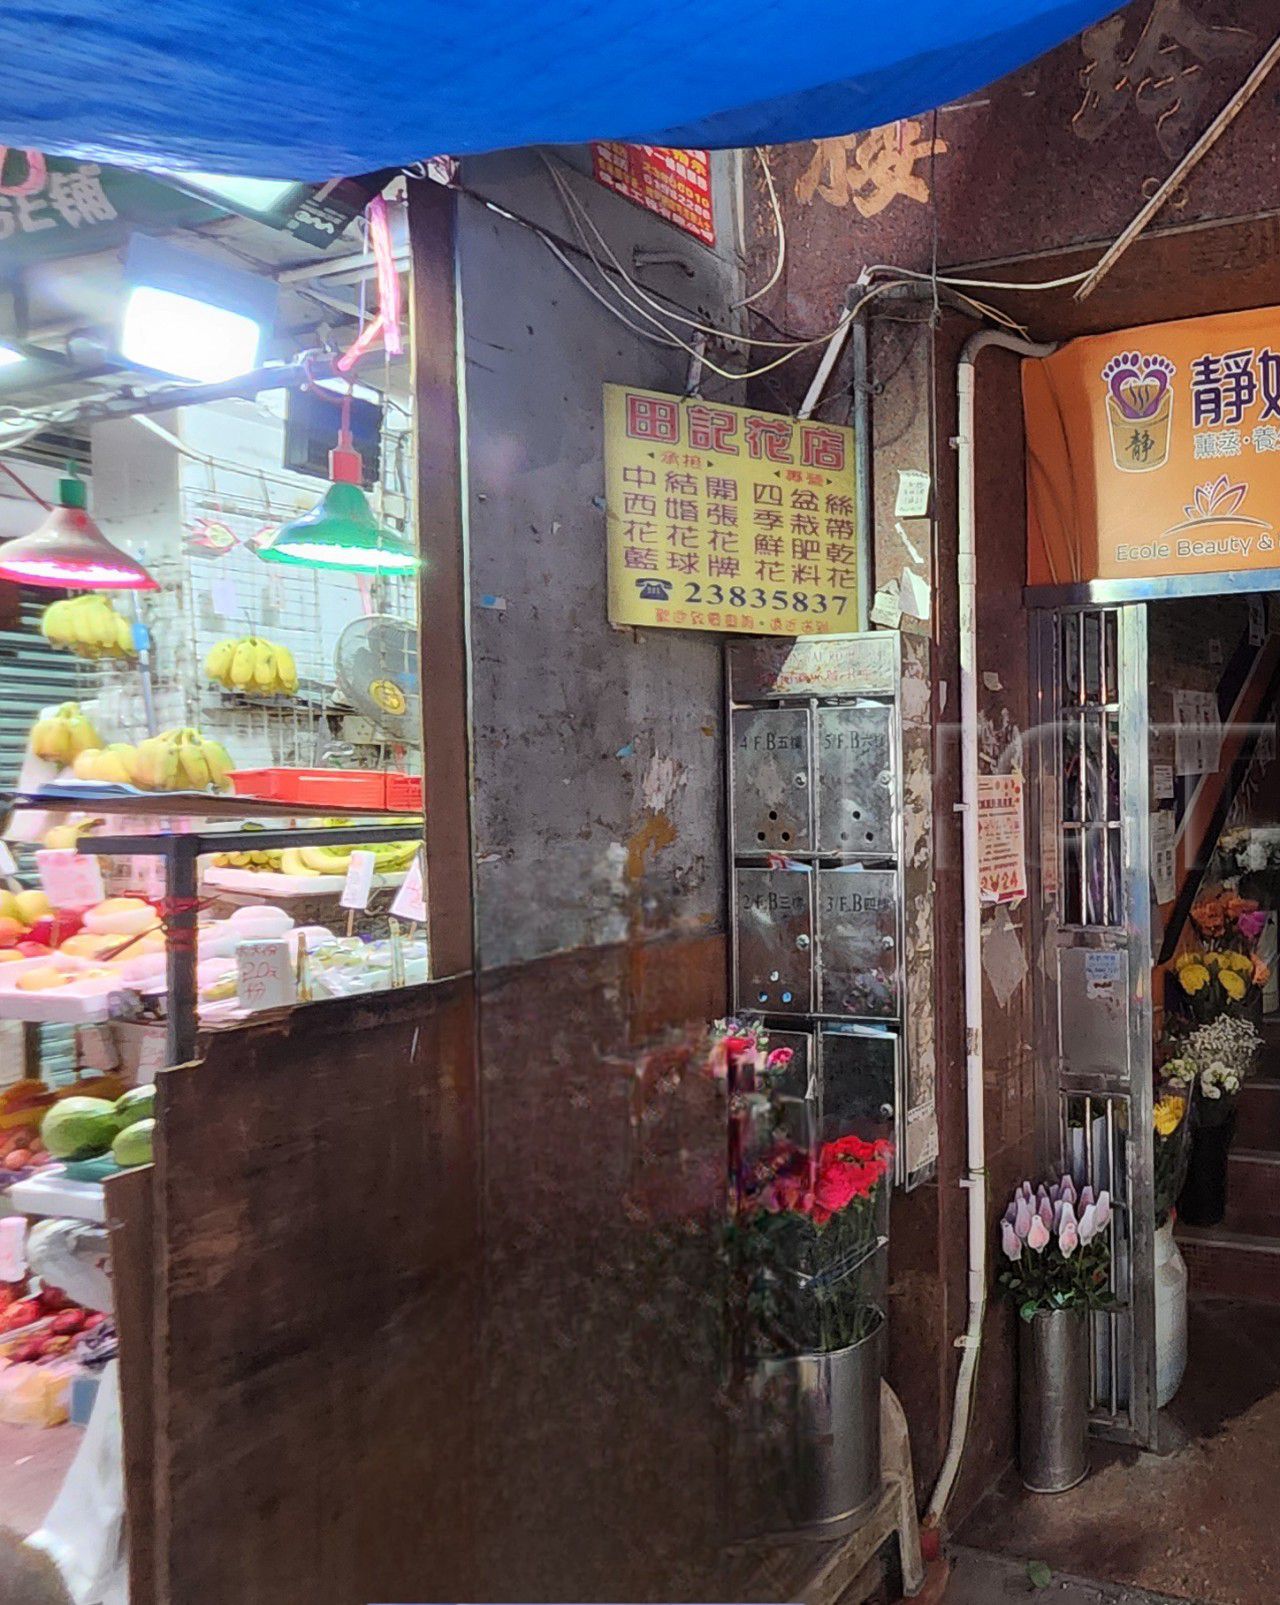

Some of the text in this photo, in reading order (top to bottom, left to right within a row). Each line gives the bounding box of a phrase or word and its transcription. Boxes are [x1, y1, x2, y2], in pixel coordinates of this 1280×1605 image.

[624, 393, 846, 472] 田記花店
[1116, 542, 1170, 562] Ecole
[1176, 535, 1252, 557] Beauty
[1258, 534, 1273, 550] &
[684, 580, 849, 616] 23835837
